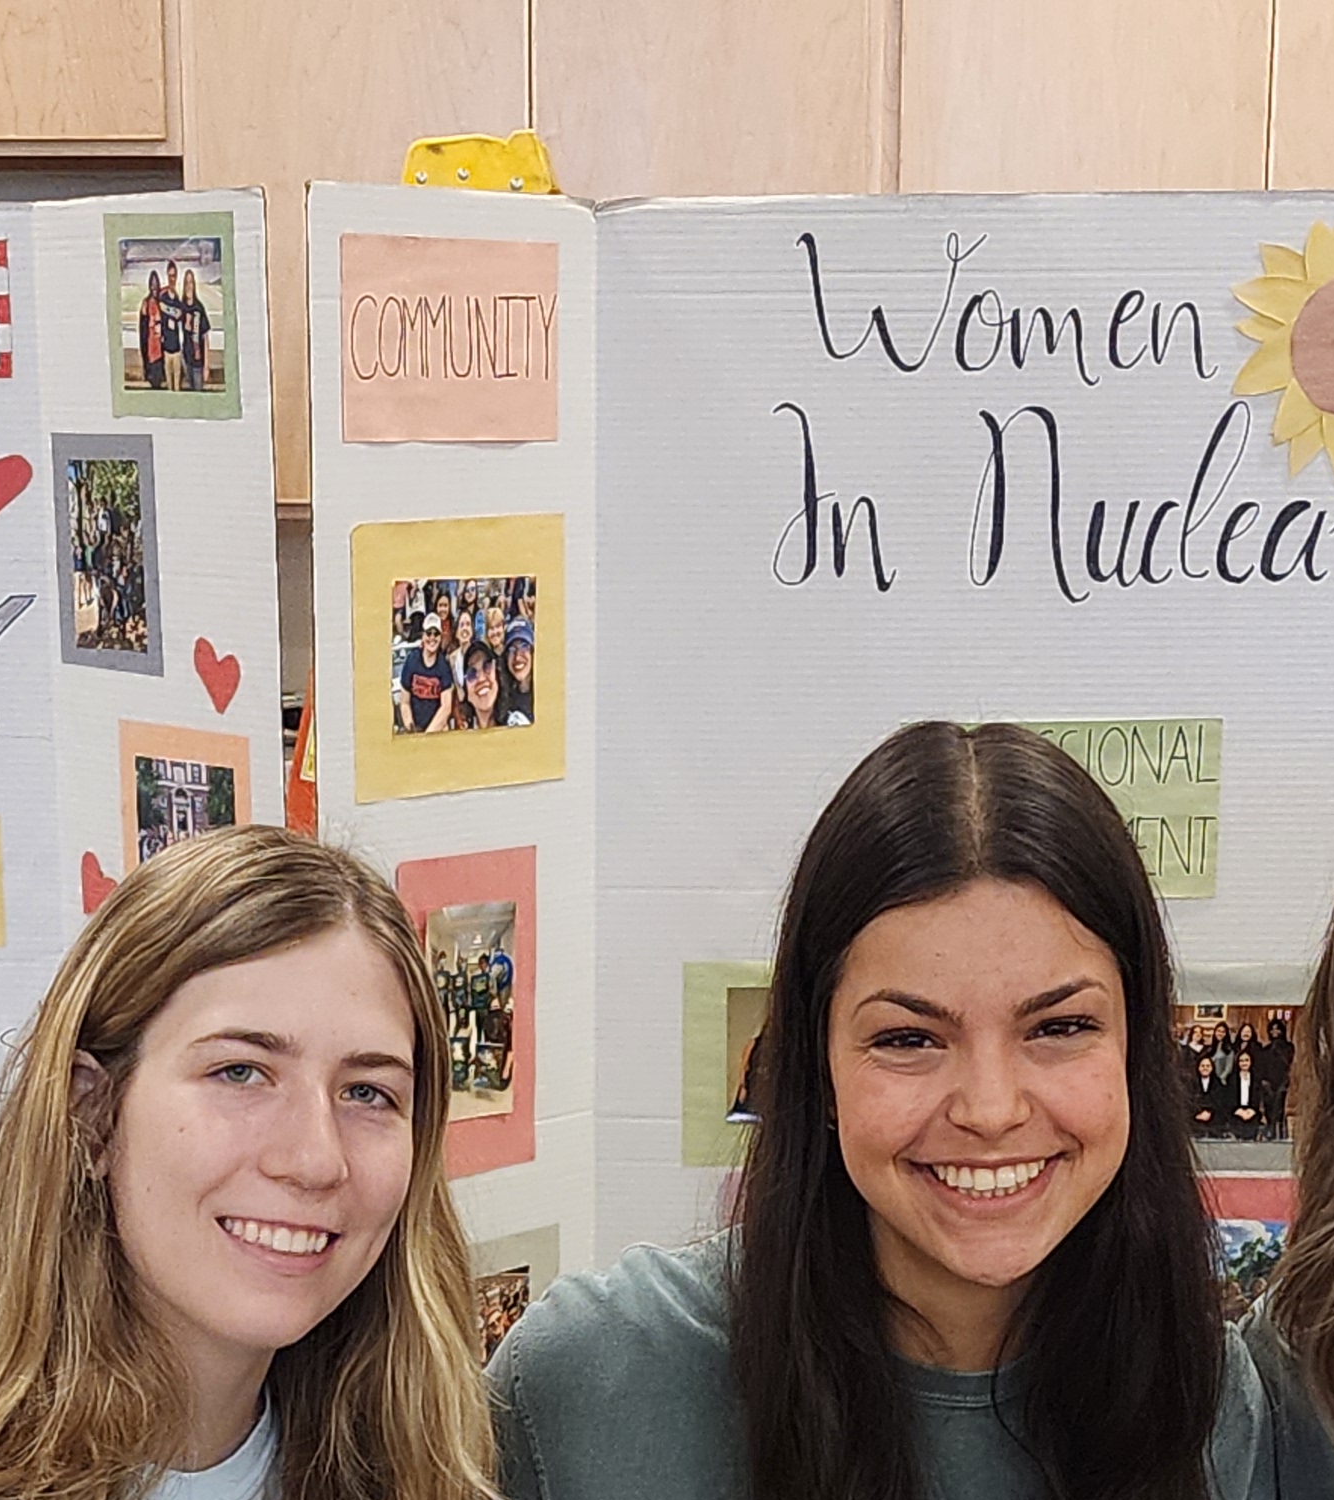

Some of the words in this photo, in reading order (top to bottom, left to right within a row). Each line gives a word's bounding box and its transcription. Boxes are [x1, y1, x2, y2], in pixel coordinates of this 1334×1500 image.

[349, 293, 557, 382] COMMUNITY
[796, 231, 1219, 386] Women
[771, 402, 898, 594] In
